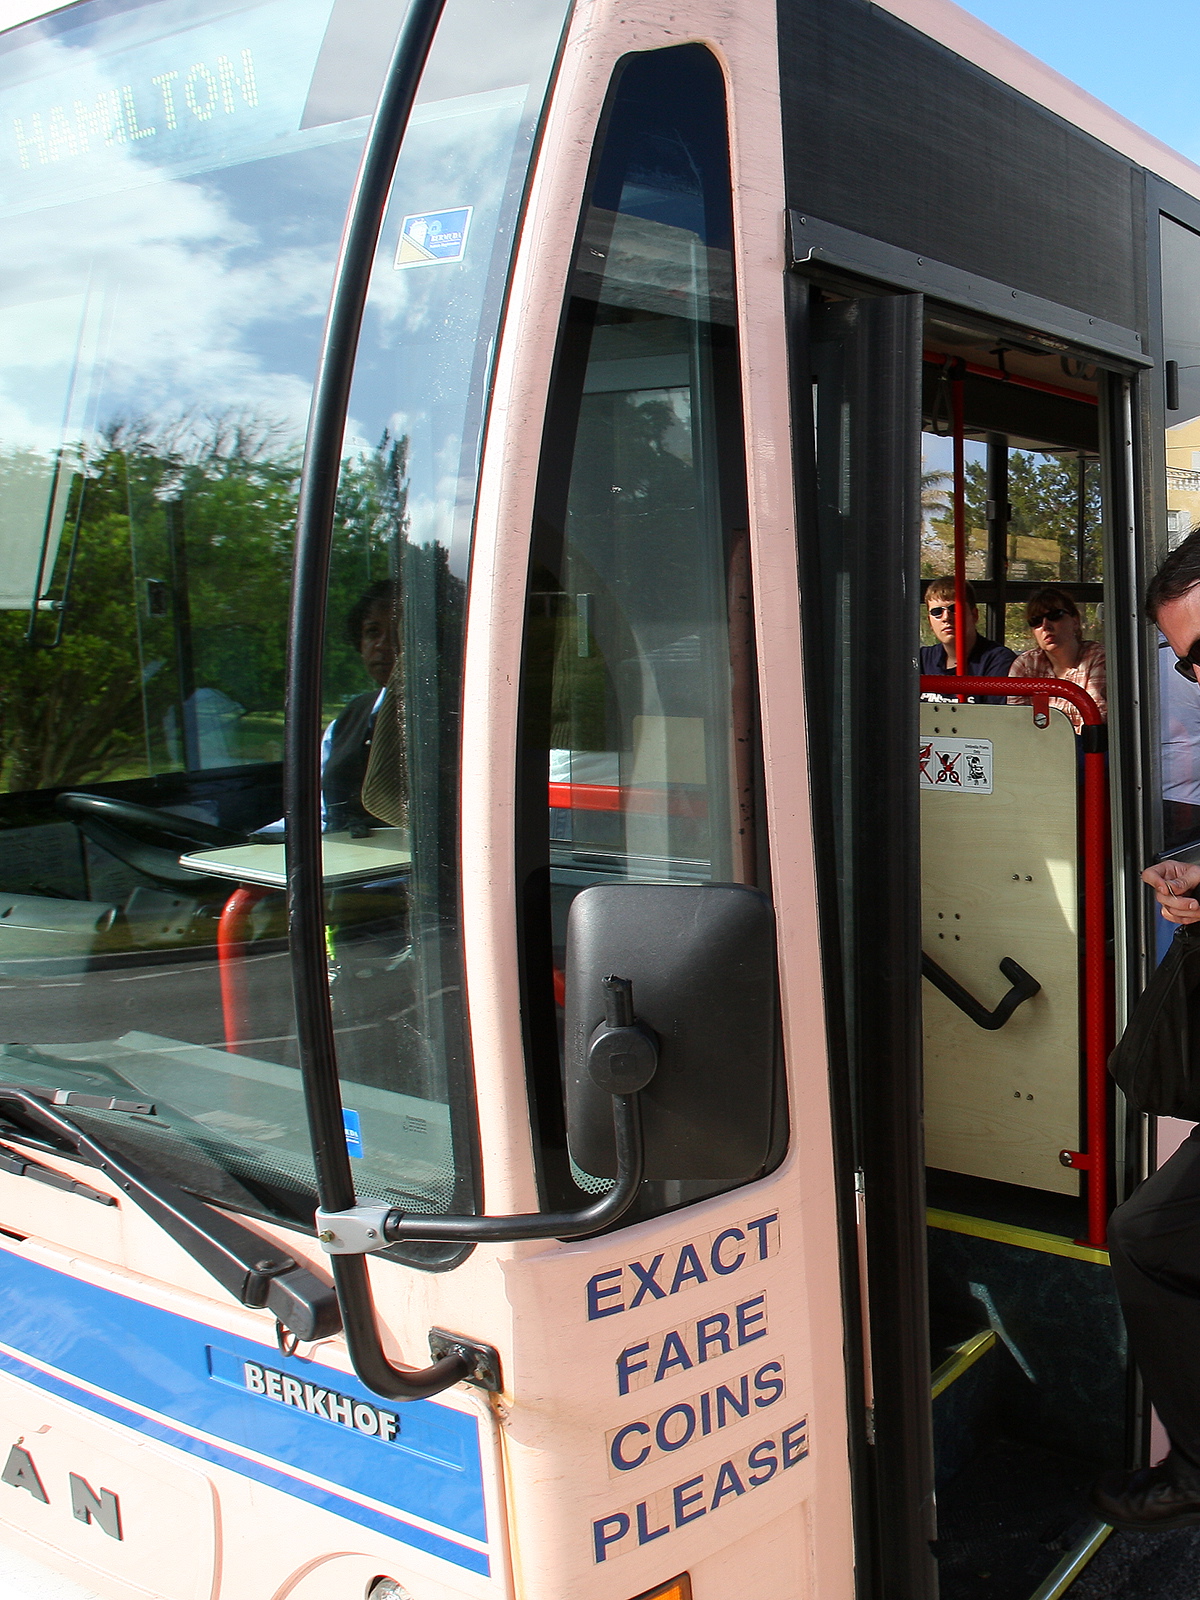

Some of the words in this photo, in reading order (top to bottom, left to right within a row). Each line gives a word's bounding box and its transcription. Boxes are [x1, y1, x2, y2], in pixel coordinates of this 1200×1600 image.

[13, 48, 259, 169] HAMILTON
[587, 1212, 778, 1321] EXACT
[617, 1294, 768, 1397] FARE
[244, 1360, 400, 1442] BERKHOF
[609, 1360, 785, 1472] COINS
[592, 1418, 809, 1564] PLEASE
